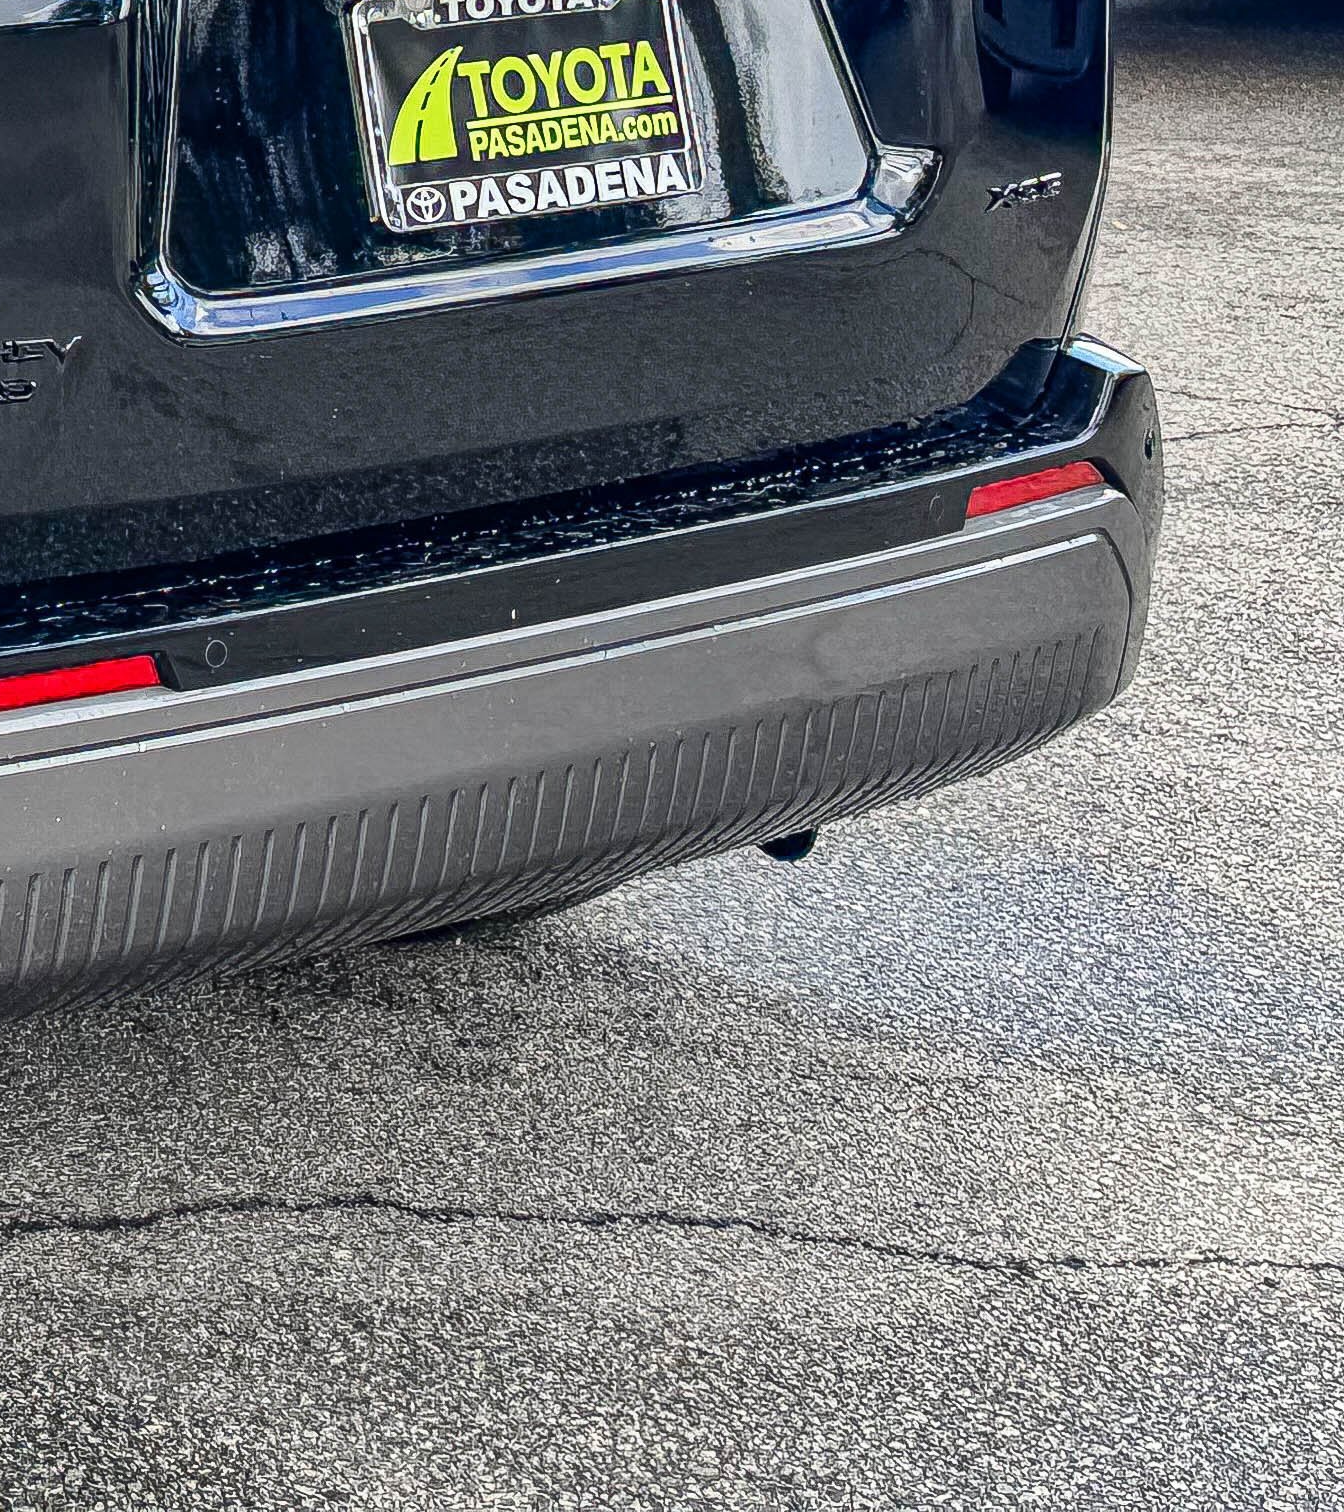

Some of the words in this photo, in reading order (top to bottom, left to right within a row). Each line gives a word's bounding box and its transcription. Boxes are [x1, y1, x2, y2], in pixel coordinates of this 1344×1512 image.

[457, 40, 672, 118] TOYOTA
[467, 110, 679, 161] PASADENA.com
[448, 154, 688, 222] PASADENA
